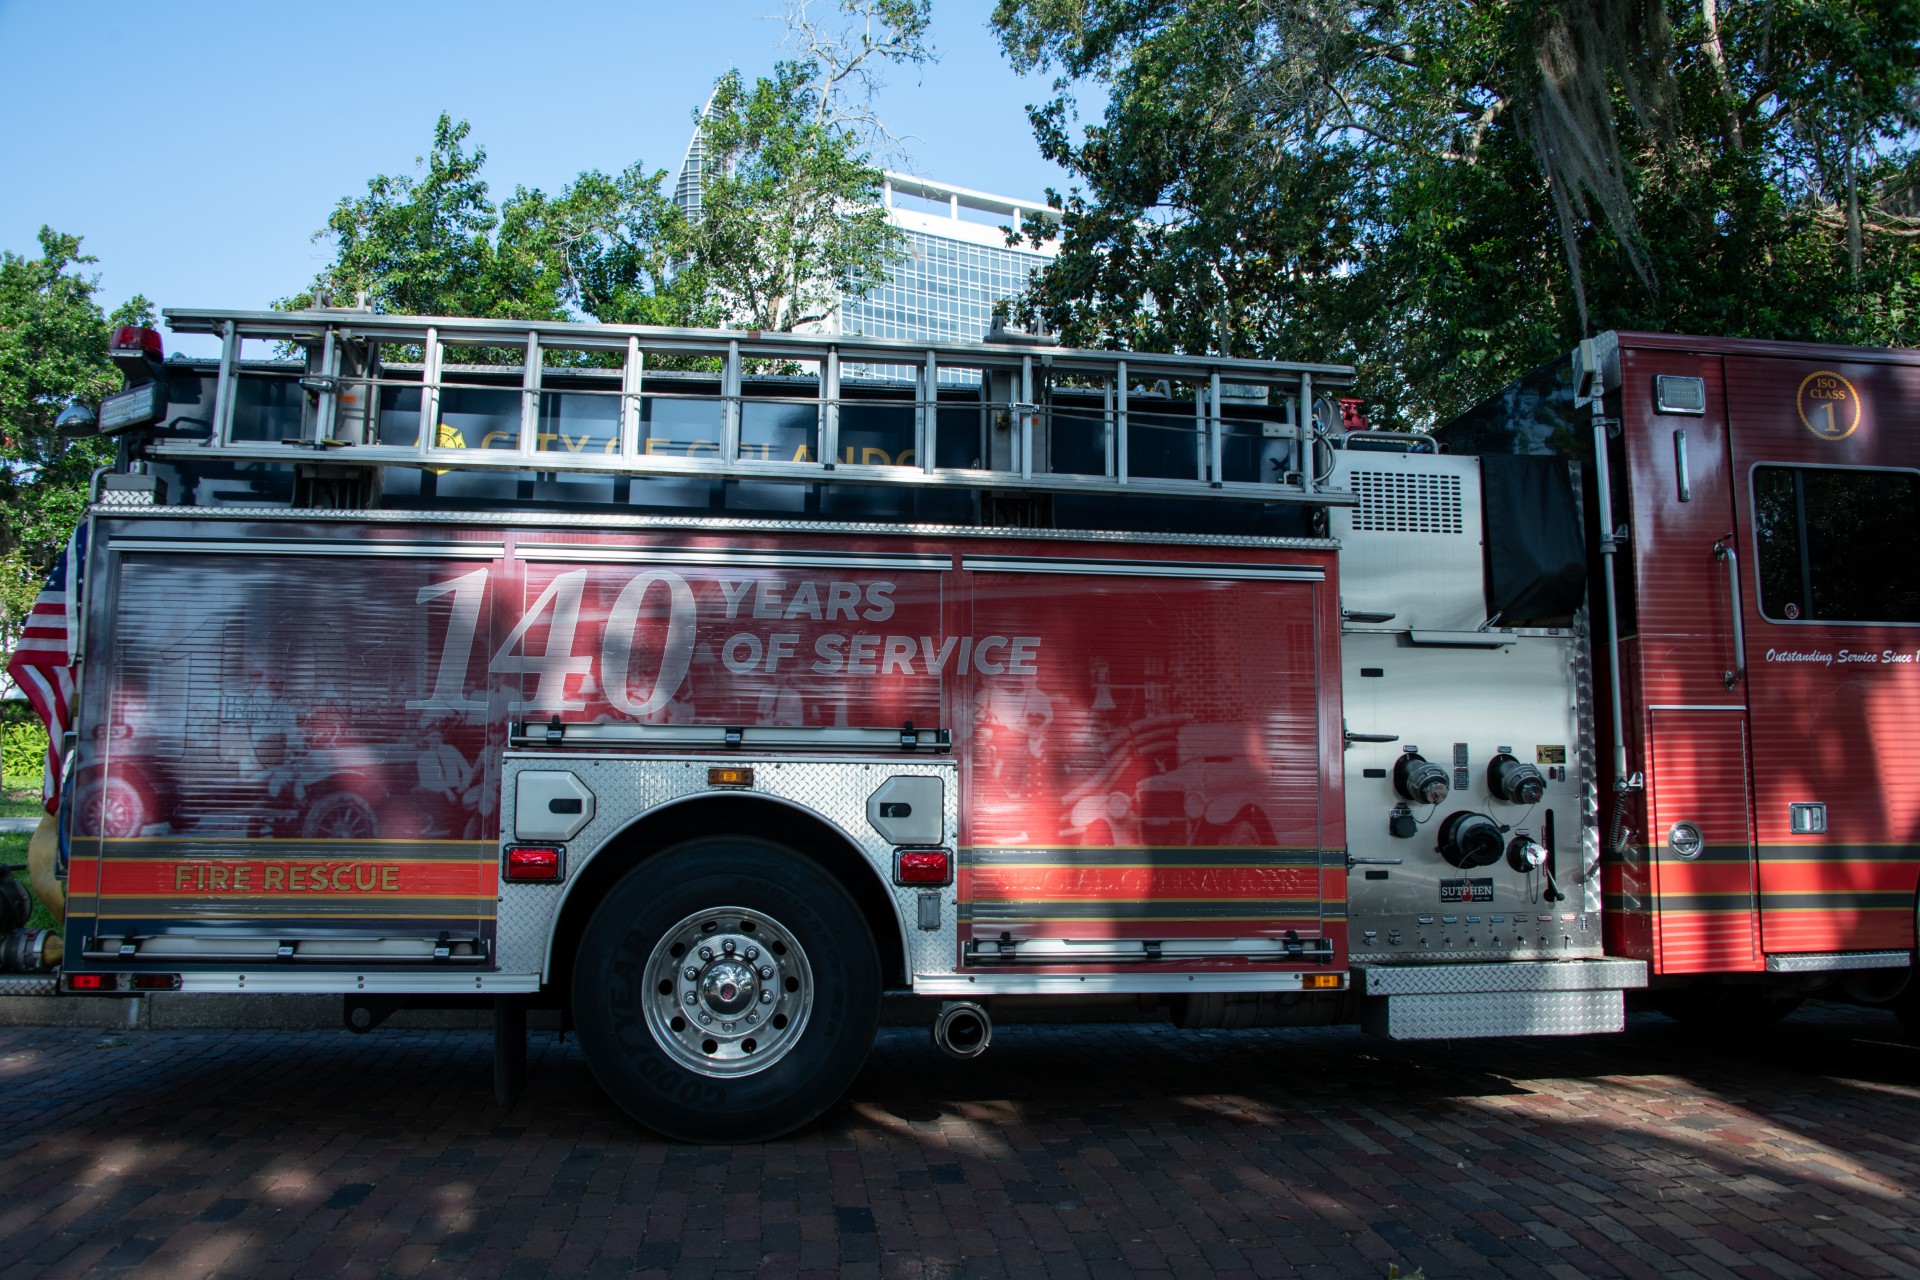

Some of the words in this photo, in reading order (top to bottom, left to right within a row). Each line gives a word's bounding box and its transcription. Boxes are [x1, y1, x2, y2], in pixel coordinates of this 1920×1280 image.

[1810, 388, 1846, 400] CLASS
[1816, 378, 1837, 389] ISO
[1819, 402, 1840, 432] 1
[686, 440, 916, 467] OADO
[716, 580, 897, 622] YEARS
[405, 566, 698, 716] 140
[721, 633, 802, 675] OF
[811, 635, 1042, 676] SERVICE
[1765, 647, 1833, 667] Outstanding
[1837, 649, 1877, 663] Service
[1881, 650, 1912, 663] Since
[174, 865, 252, 891] FIRE
[263, 865, 400, 892] RESCUE
[1441, 886, 1492, 896] SUTPHEN
